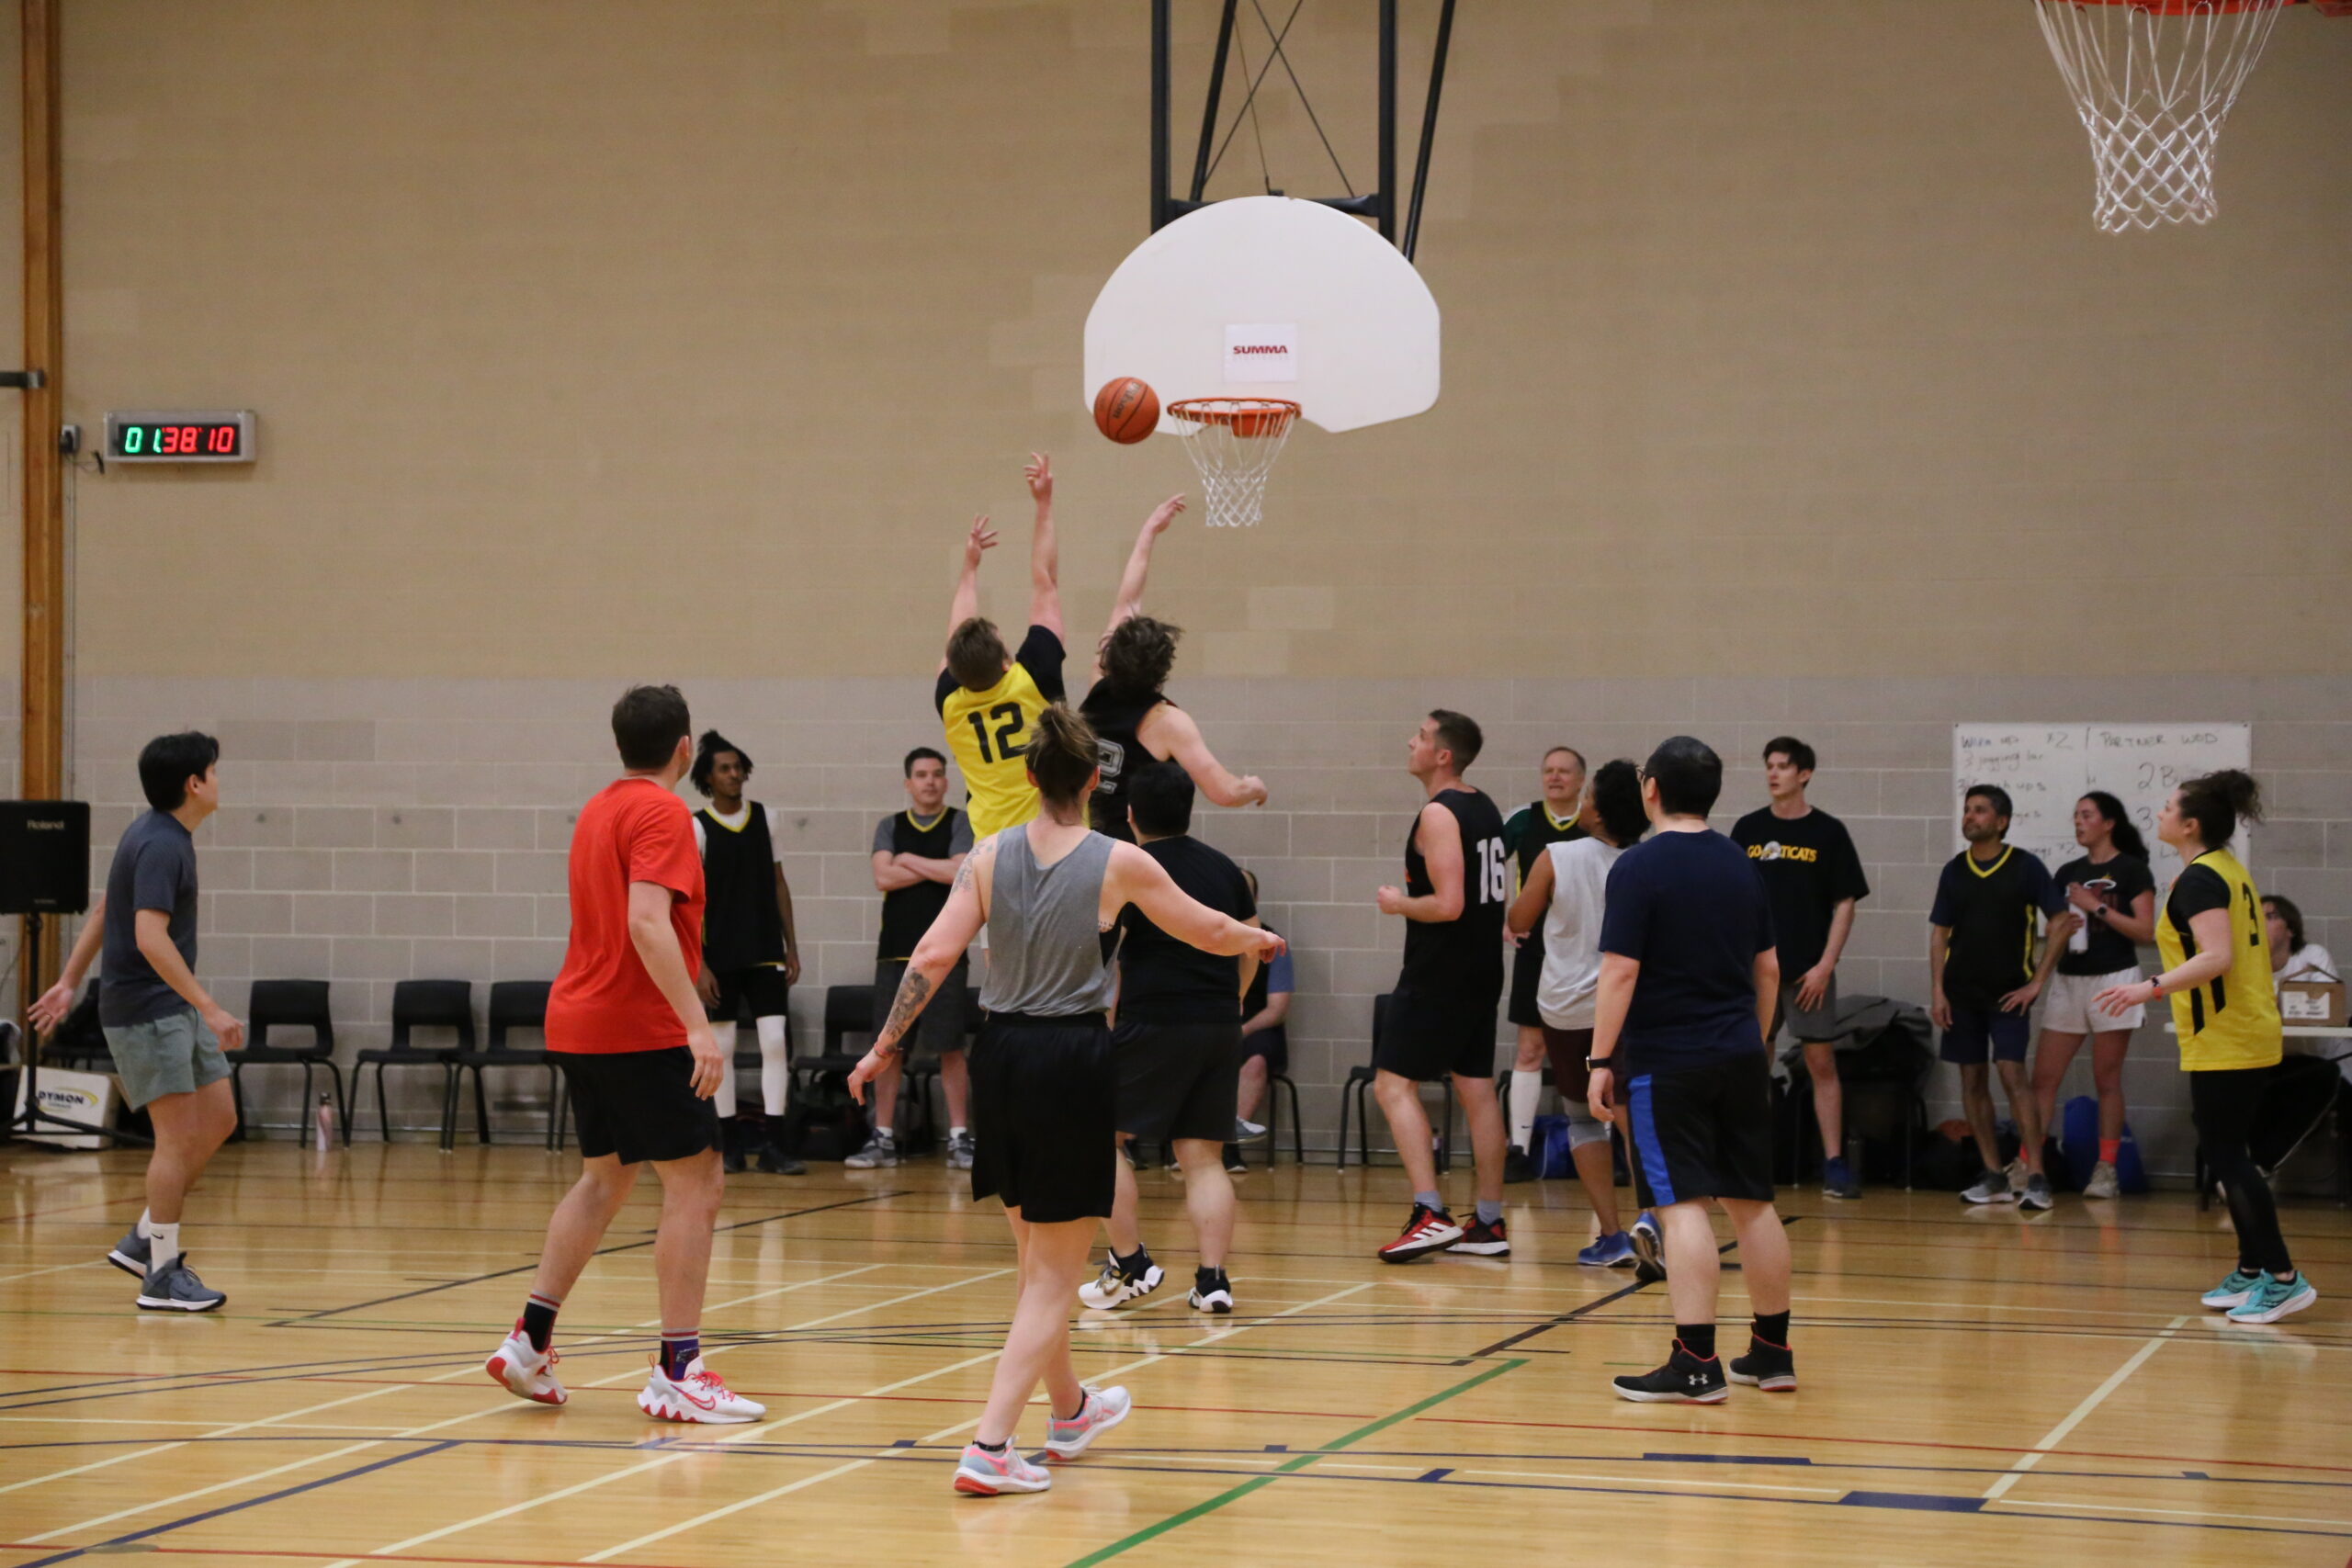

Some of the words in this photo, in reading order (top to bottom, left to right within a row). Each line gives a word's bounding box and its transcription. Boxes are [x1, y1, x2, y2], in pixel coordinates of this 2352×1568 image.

[1233, 345, 1288, 355] SUMMA
[967, 702, 1027, 763] 12
[27, 819, 65, 830] Roland
[1747, 844, 1763, 859] GO
[1780, 844, 1817, 863] TICATS
[1476, 836, 1506, 905] 16
[38, 1090, 85, 1105] DYMON
